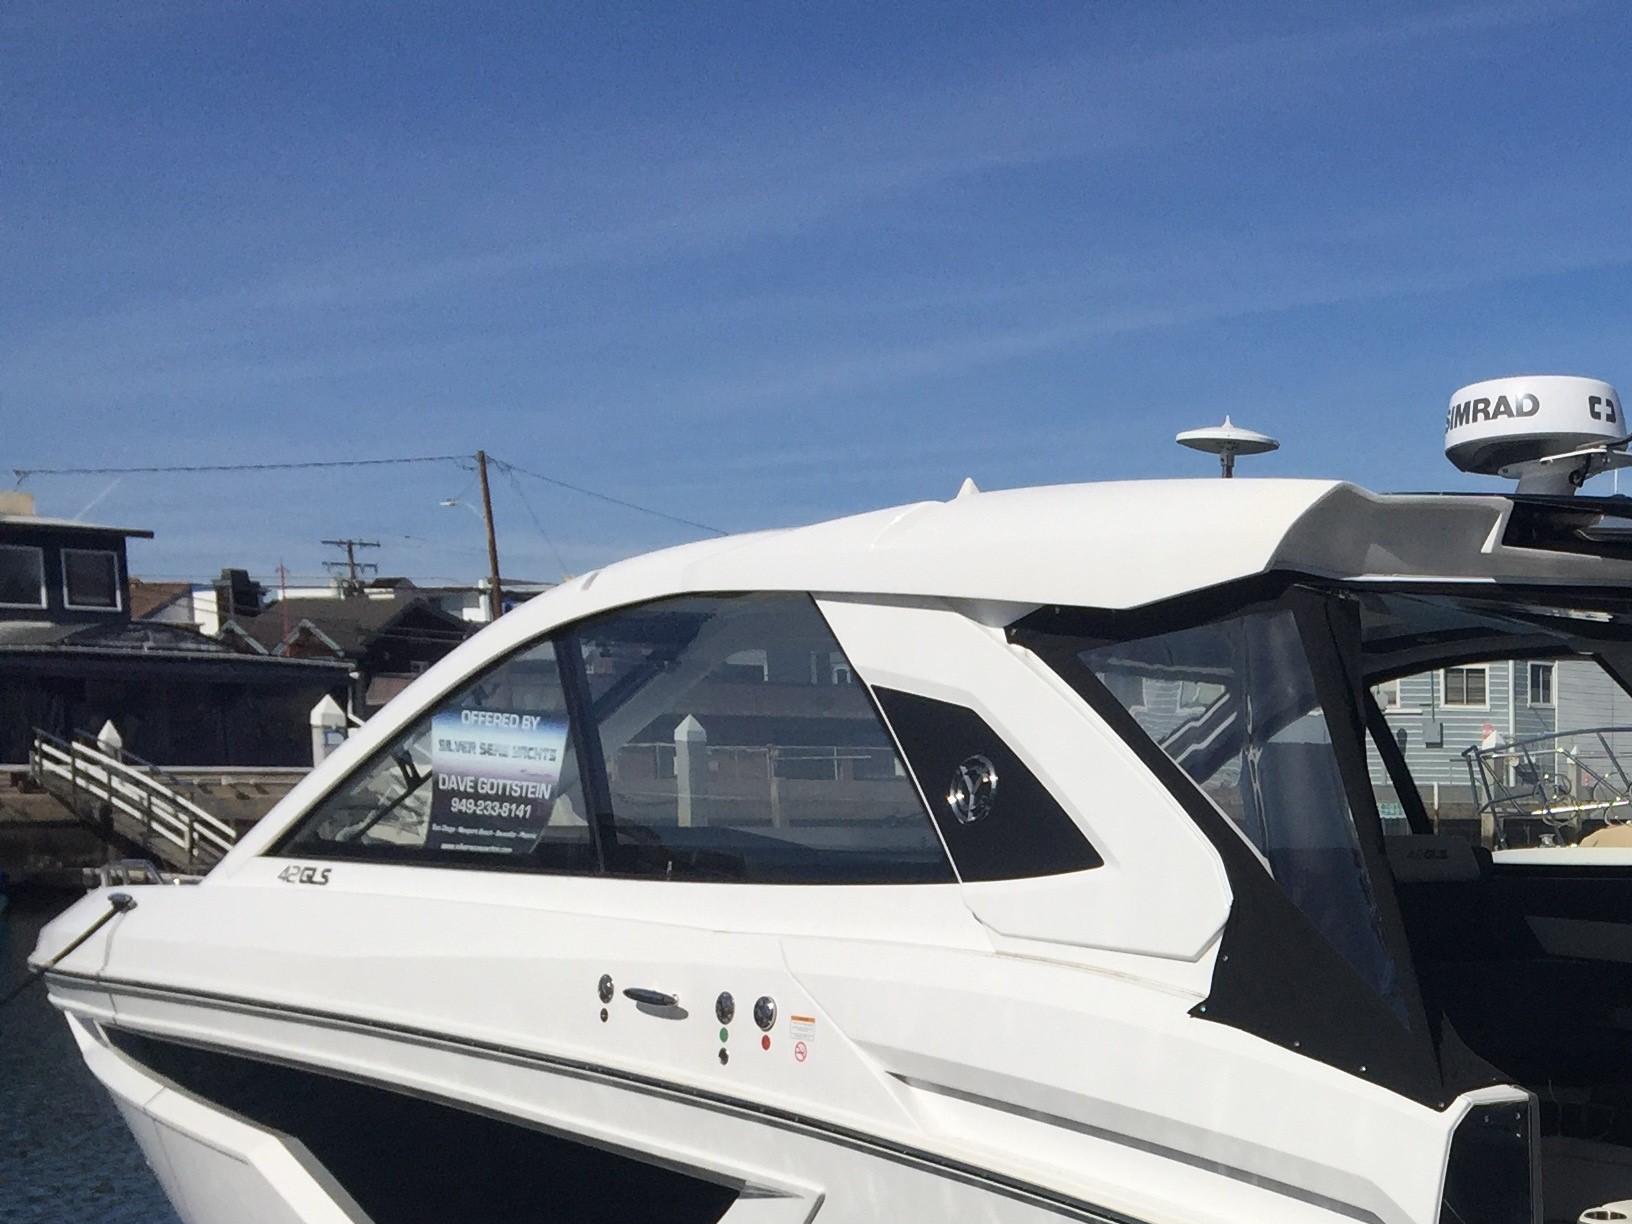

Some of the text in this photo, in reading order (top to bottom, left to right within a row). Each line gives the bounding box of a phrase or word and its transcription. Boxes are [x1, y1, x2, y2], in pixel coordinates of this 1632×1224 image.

[462, 710, 541, 731] OFFERED BY
[438, 773, 552, 800] DAVE GOTTSTEIN
[451, 797, 532, 819] 949-233-8141
